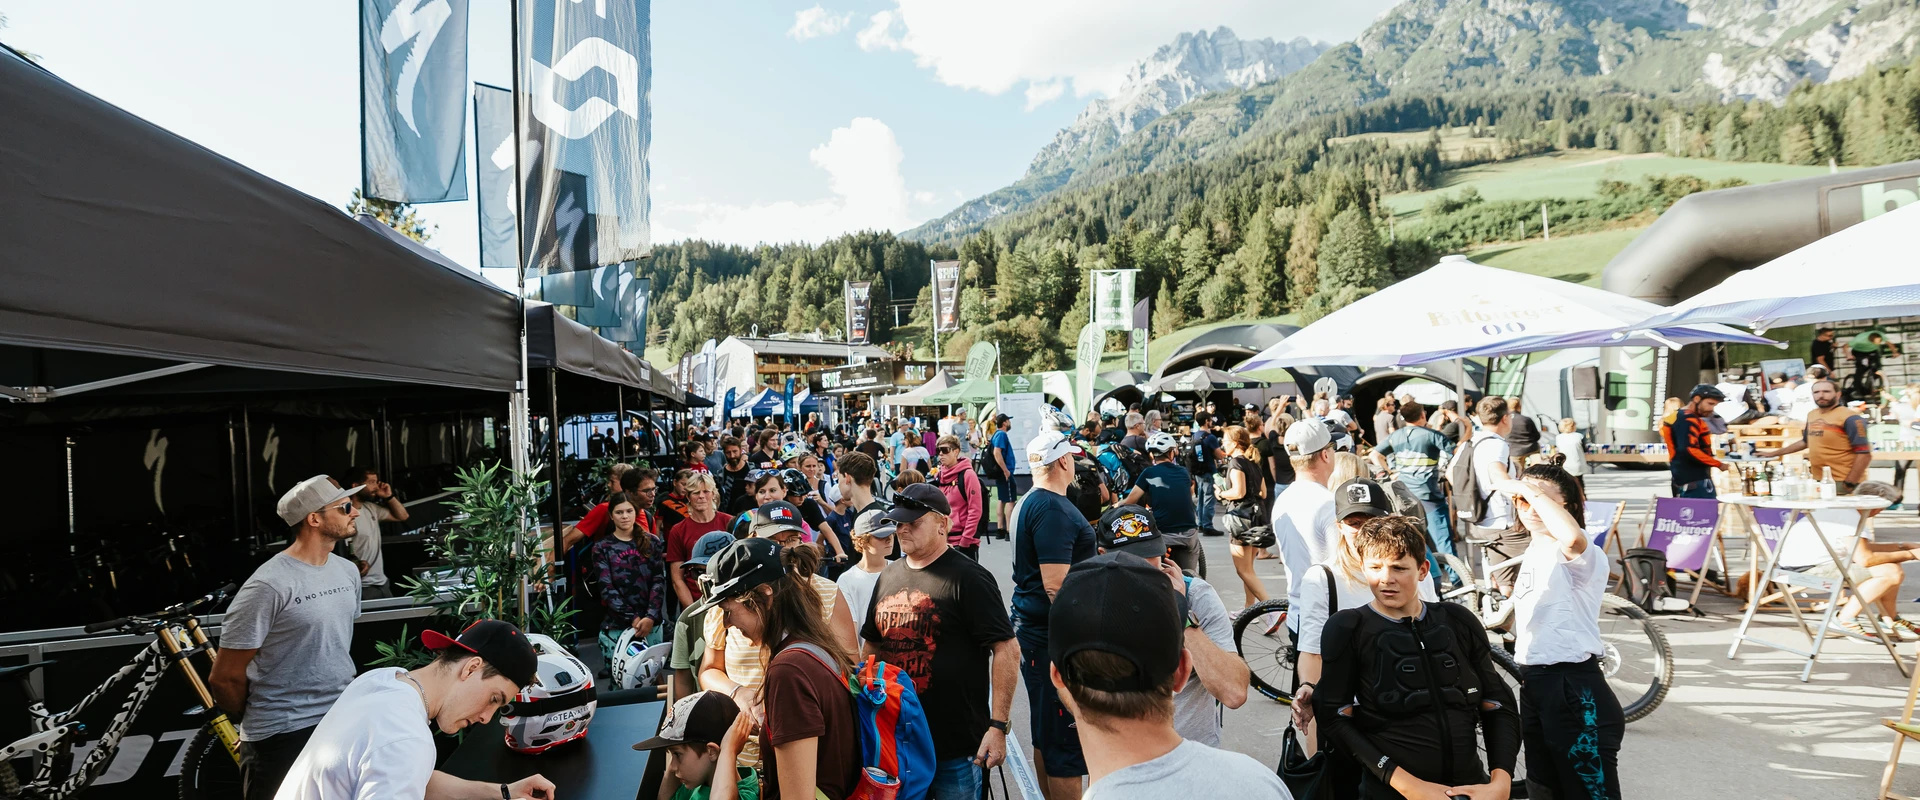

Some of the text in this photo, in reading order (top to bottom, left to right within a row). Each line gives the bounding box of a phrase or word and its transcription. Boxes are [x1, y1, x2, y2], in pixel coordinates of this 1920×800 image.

[1606, 347, 1655, 431] bik
[1656, 517, 1713, 536] Bitburger
[305, 593, 317, 601] NO
[877, 611, 933, 637] PREMIUM
